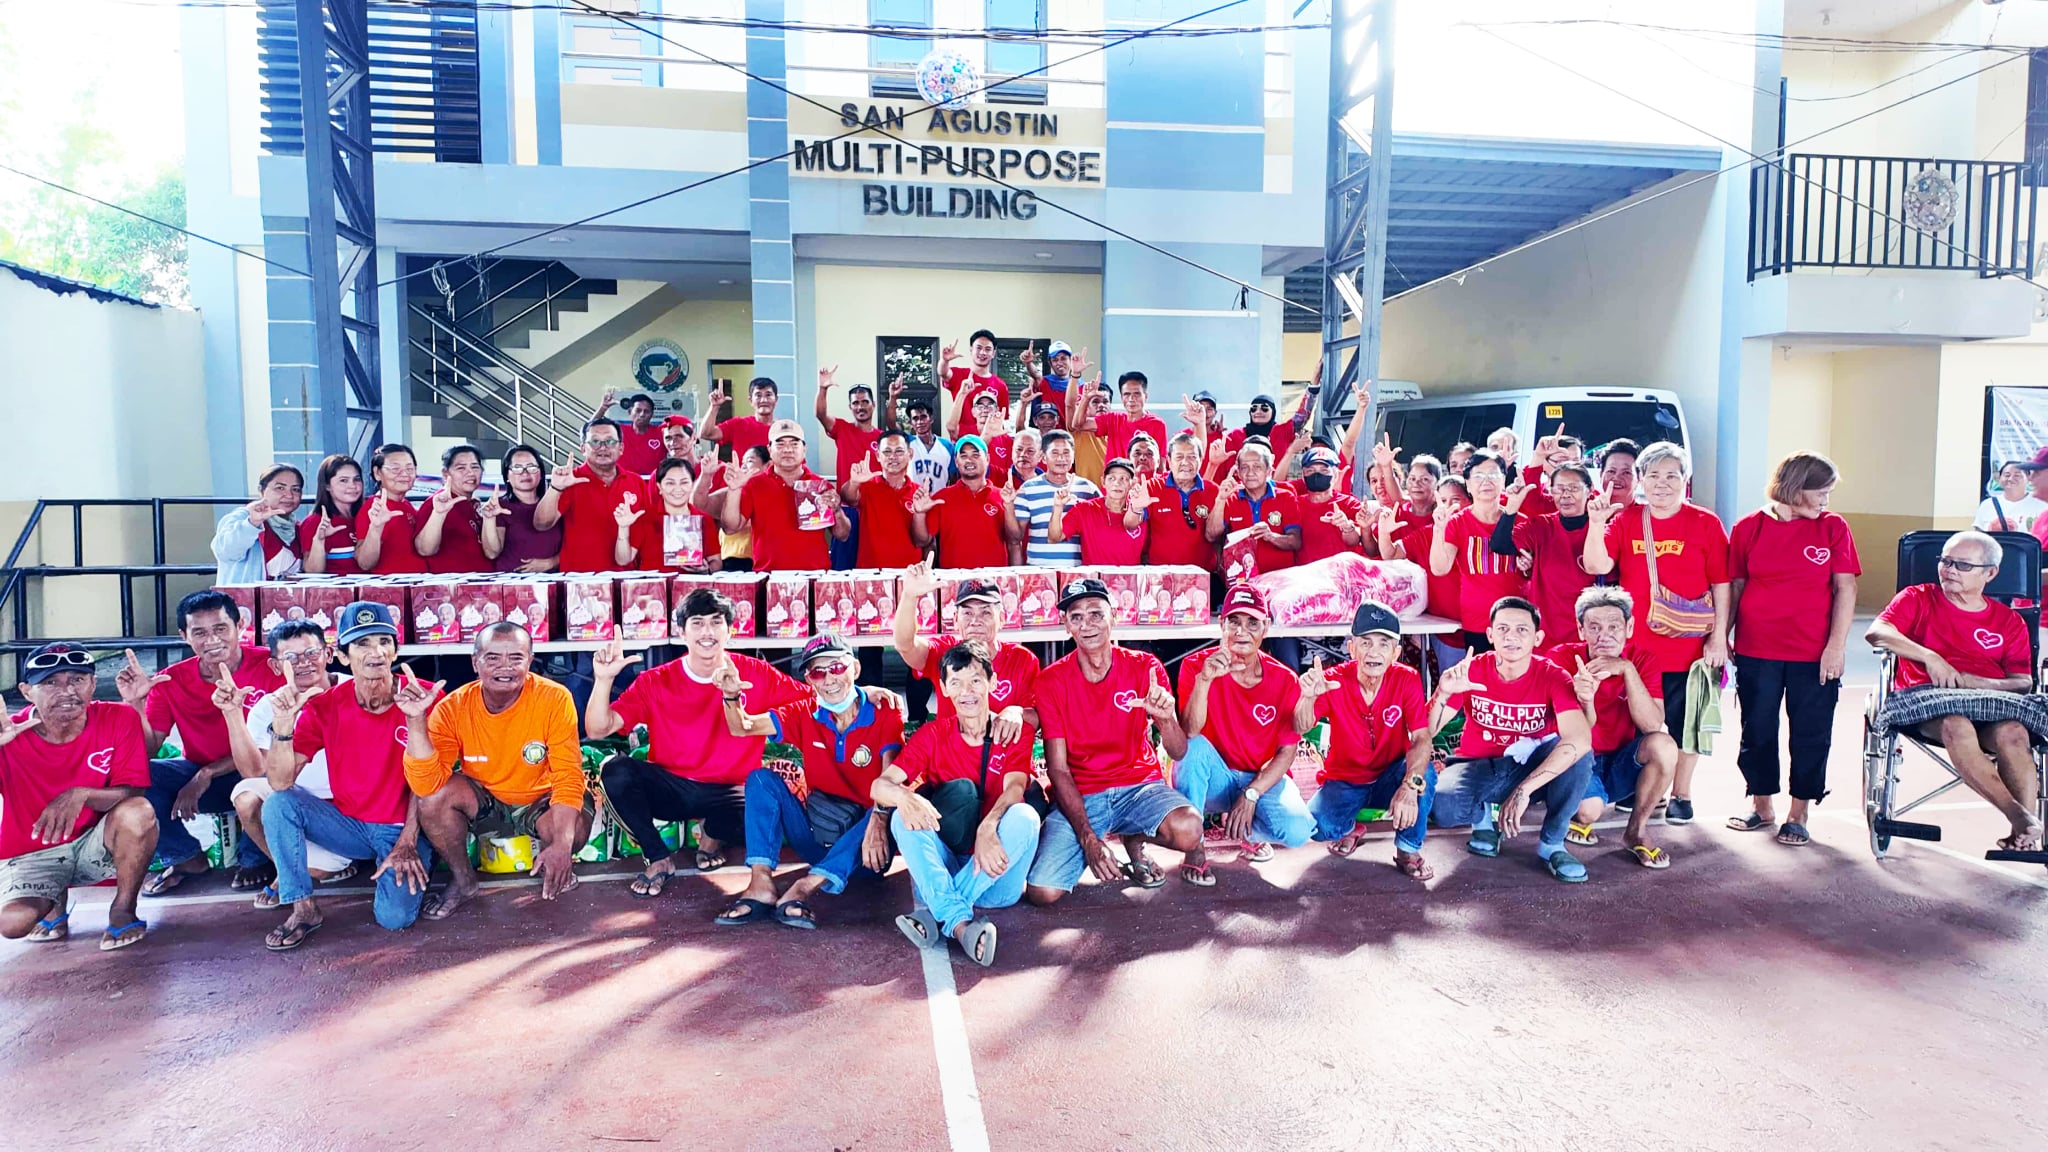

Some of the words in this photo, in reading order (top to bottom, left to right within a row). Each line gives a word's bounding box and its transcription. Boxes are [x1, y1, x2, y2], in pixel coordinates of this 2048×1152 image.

[840, 102, 904, 130] SAN
[927, 109, 1058, 137] AGUSTIN
[794, 139, 1100, 183] MULTI-PURPOSE
[863, 184, 1037, 220] BUILDING
[1637, 543, 1679, 552] LVI'S
[1471, 697, 1490, 713] WE
[1492, 704, 1515, 721] ALL
[1517, 707, 1547, 721] PLAY
[1471, 709, 1494, 726] FOR
[1496, 718, 1546, 732] CANADA
